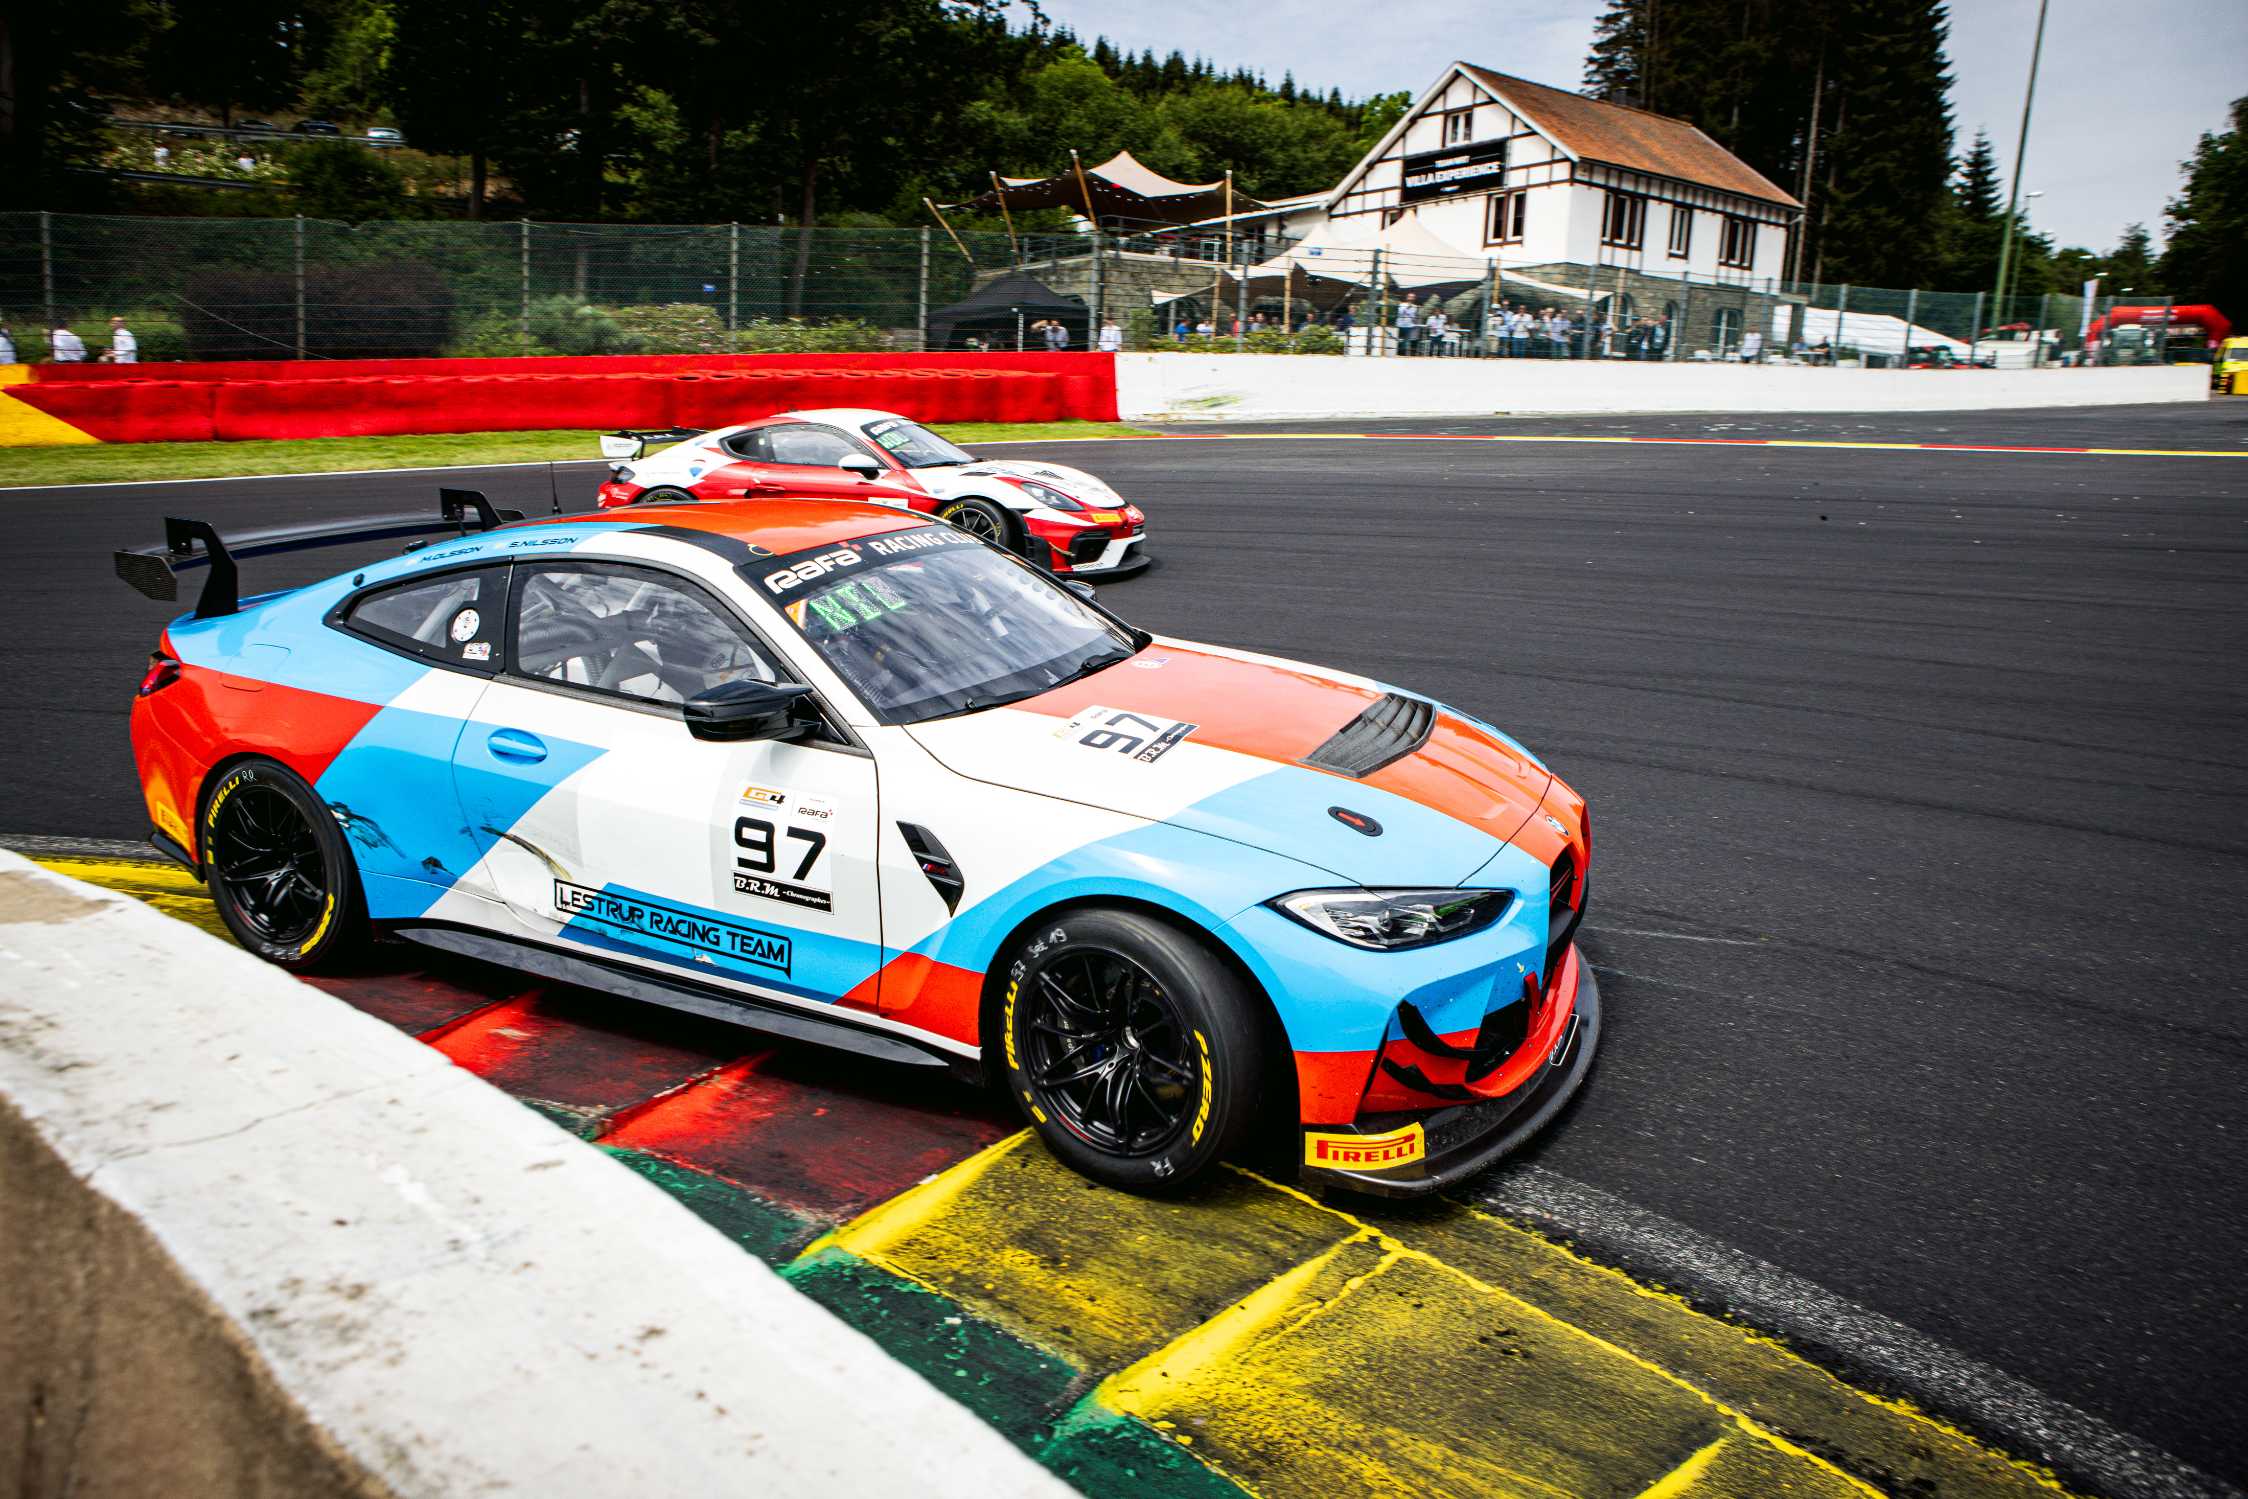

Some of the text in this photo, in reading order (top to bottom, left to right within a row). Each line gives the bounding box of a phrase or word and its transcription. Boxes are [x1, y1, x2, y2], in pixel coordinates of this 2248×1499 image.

[508, 537, 579, 548] S.NILSSON
[867, 533, 945, 555] RACING
[1078, 713, 1161, 754] 97
[208, 776, 240, 828] PIRELLI
[735, 816, 826, 881] 97
[650, 911, 721, 946] RACING
[726, 931, 785, 963] TEAM
[1004, 980, 1019, 1071] PIRELLI
[1192, 1055, 1212, 1142] ZERO
[1316, 1133, 1416, 1162] PIRELLI
